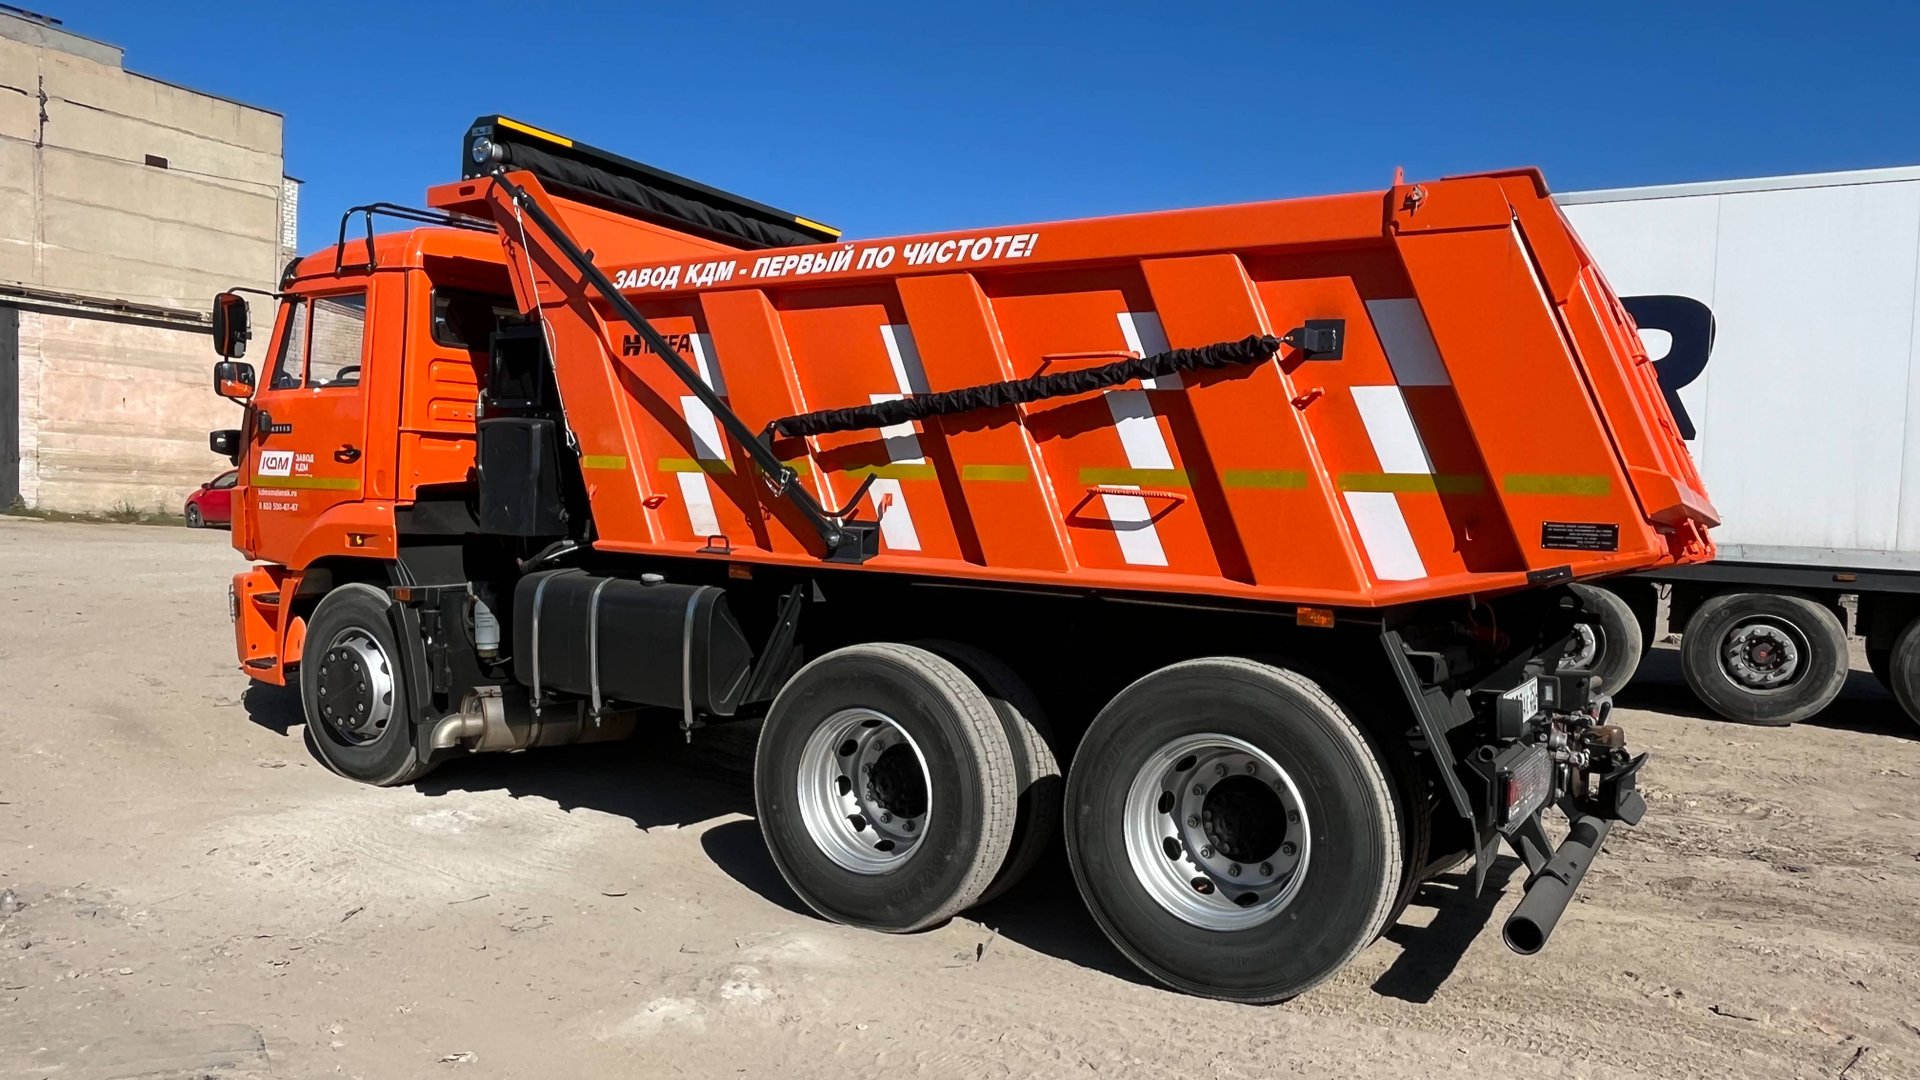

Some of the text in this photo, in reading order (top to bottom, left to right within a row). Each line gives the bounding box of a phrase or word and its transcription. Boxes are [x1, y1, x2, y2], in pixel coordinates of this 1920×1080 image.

[612, 265, 682, 290] ЗАВОД
[684, 260, 736, 288] КДМ
[750, 244, 855, 279] ПЕРВЫЙ
[856, 245, 895, 270] ПО
[902, 233, 1040, 266] ЧИСТОТЕ!
[295, 454, 314, 463] ЗАВОД
